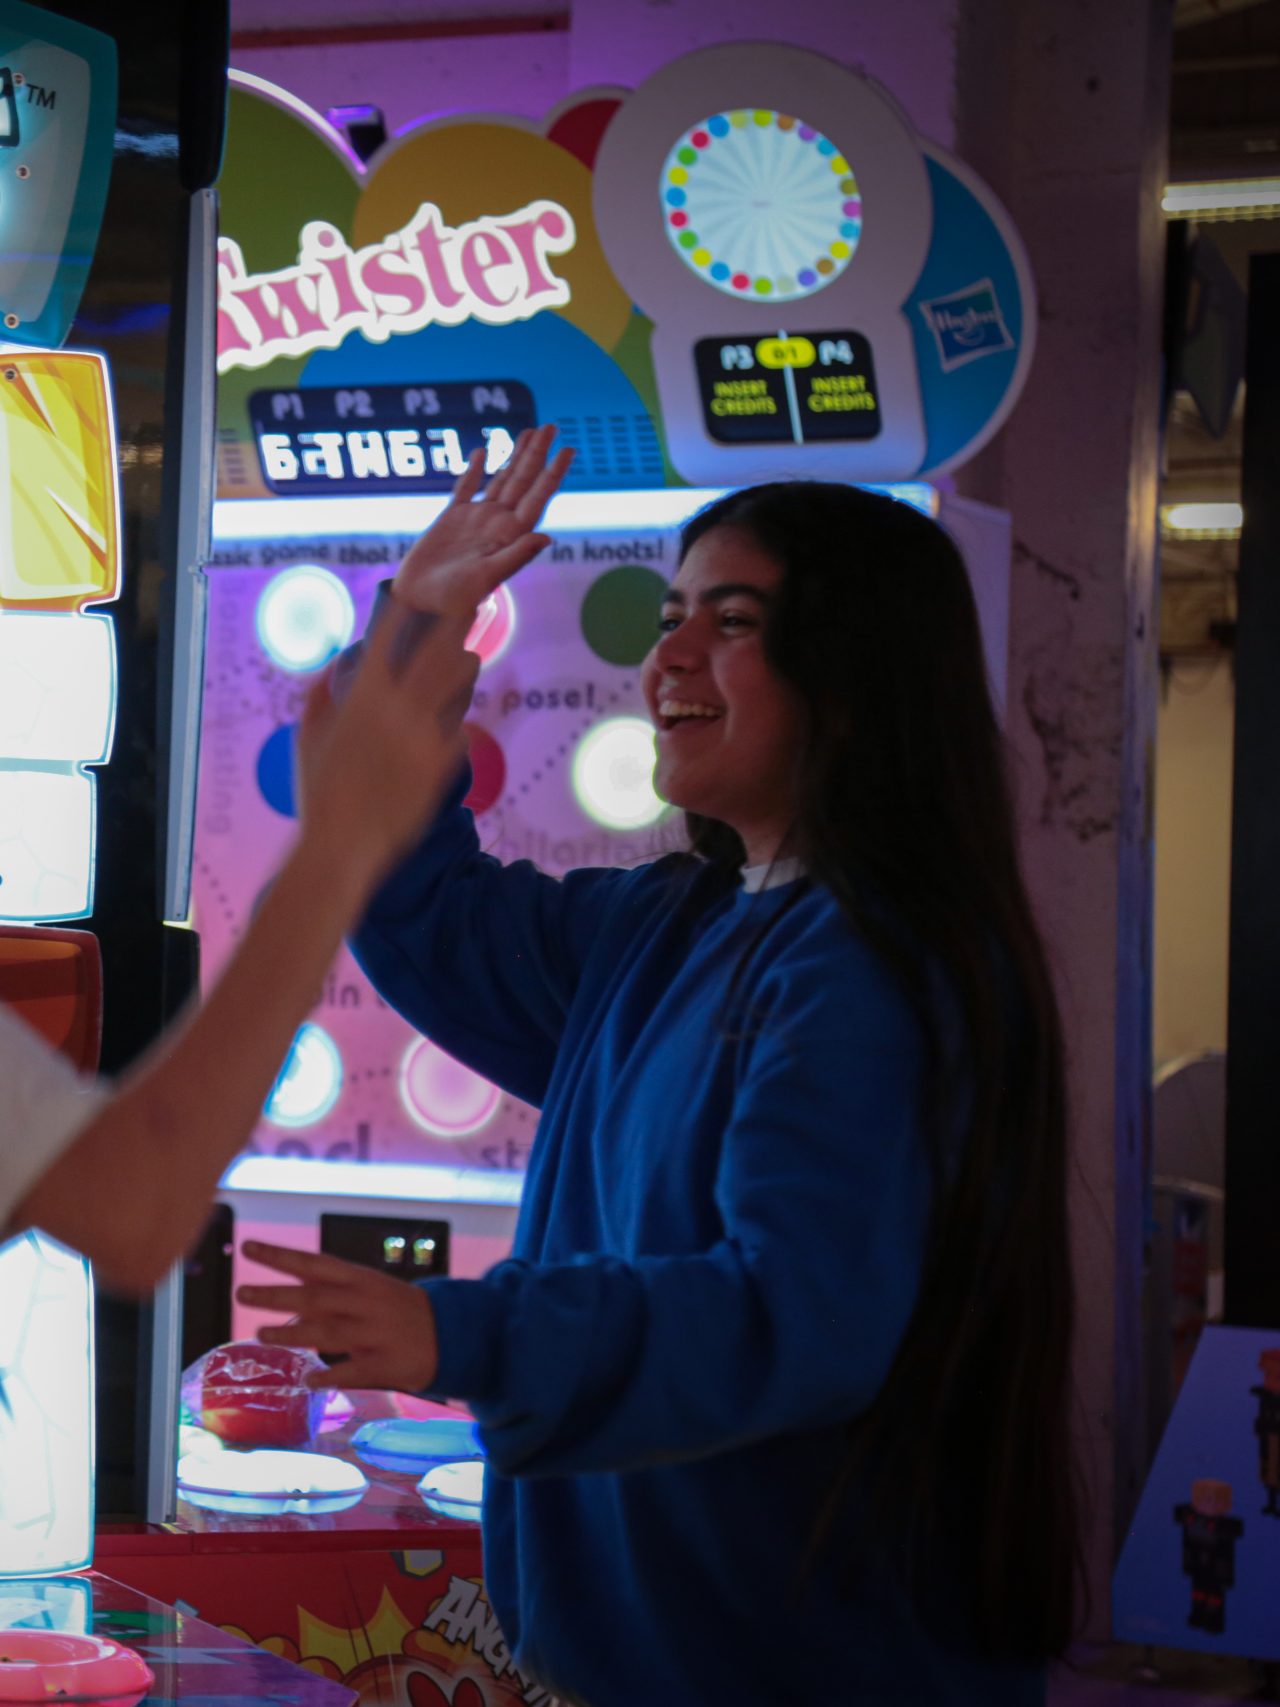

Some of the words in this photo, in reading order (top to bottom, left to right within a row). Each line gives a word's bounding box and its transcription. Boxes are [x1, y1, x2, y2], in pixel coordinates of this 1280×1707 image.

[713, 379, 768, 398] INSERT
[810, 374, 867, 395] INSERT
[271, 393, 304, 420] P1
[334, 389, 375, 418] P2
[403, 387, 440, 416] P3
[472, 385, 511, 413] P4
[710, 395, 778, 416] CREDITS
[807, 391, 876, 413] CREDITS
